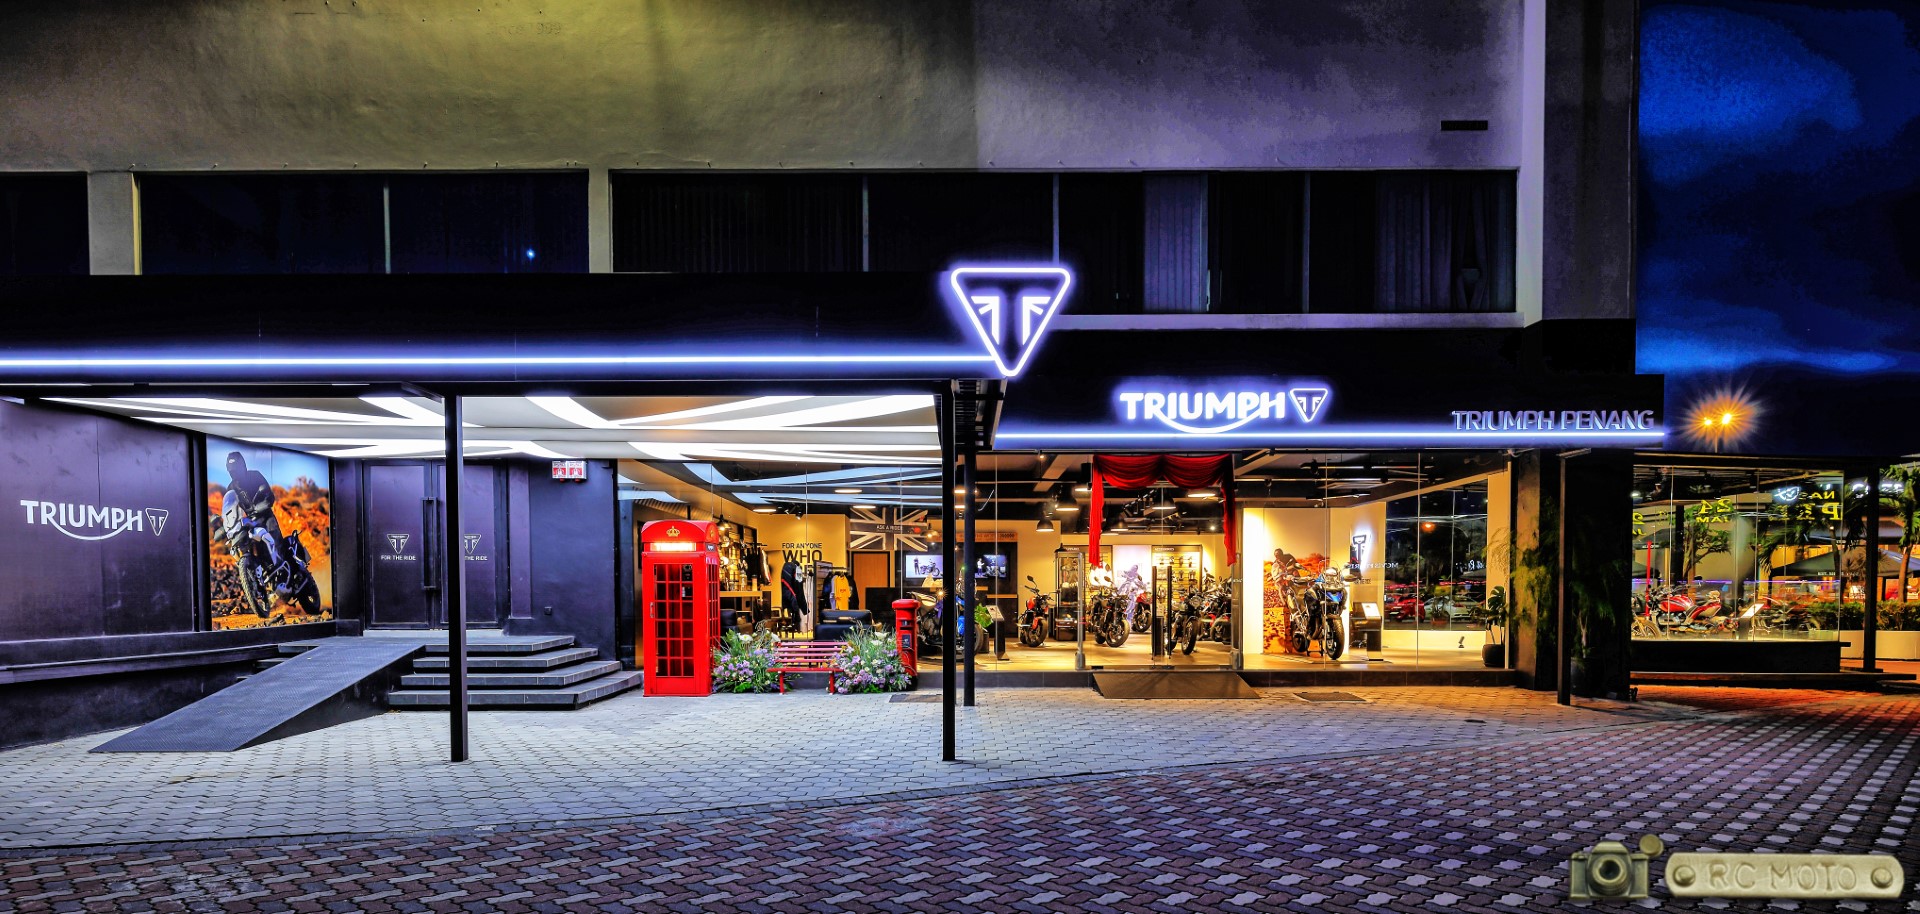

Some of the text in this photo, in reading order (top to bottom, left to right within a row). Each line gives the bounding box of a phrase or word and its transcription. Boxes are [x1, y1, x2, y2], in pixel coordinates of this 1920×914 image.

[1119, 391, 1286, 434] TRIUMPH
[1451, 409, 1655, 430] TRIUMPH PENANG
[20, 499, 143, 541] TRIUMPH
[782, 549, 822, 564] WHO
